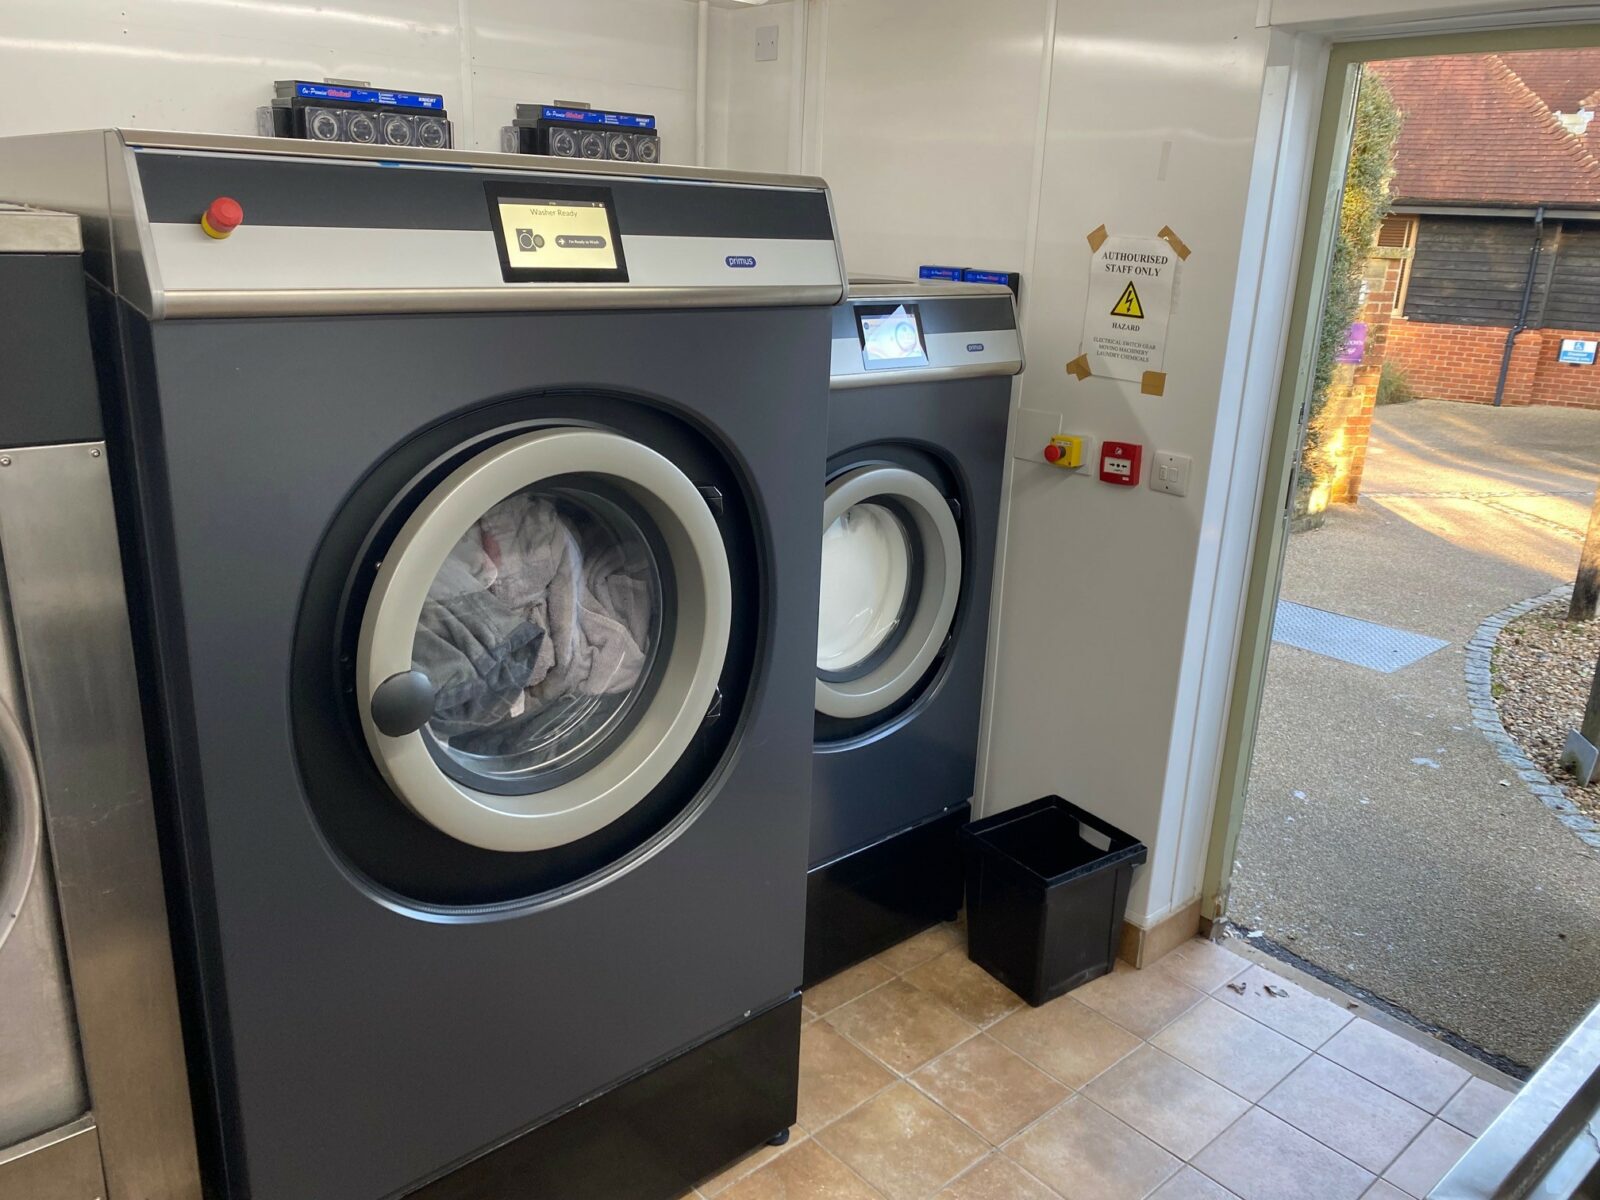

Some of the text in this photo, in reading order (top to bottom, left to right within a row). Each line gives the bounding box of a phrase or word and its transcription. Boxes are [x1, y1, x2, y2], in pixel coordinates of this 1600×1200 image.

[530, 208, 578, 218] Washer Ready
[728, 257, 754, 266] primus
[1102, 251, 1168, 265] AUTHOURISED
[1105, 263, 1161, 277] STAFF ONLY
[1112, 322, 1140, 332] HAZARD
[1093, 336, 1121, 346] ELECTRICAL
[1122, 340, 1141, 348] SWITCH
[1098, 344, 1149, 355] MOVING MACHINERY
[1096, 350, 1149, 362] LAUNDRY CHEMICALS
